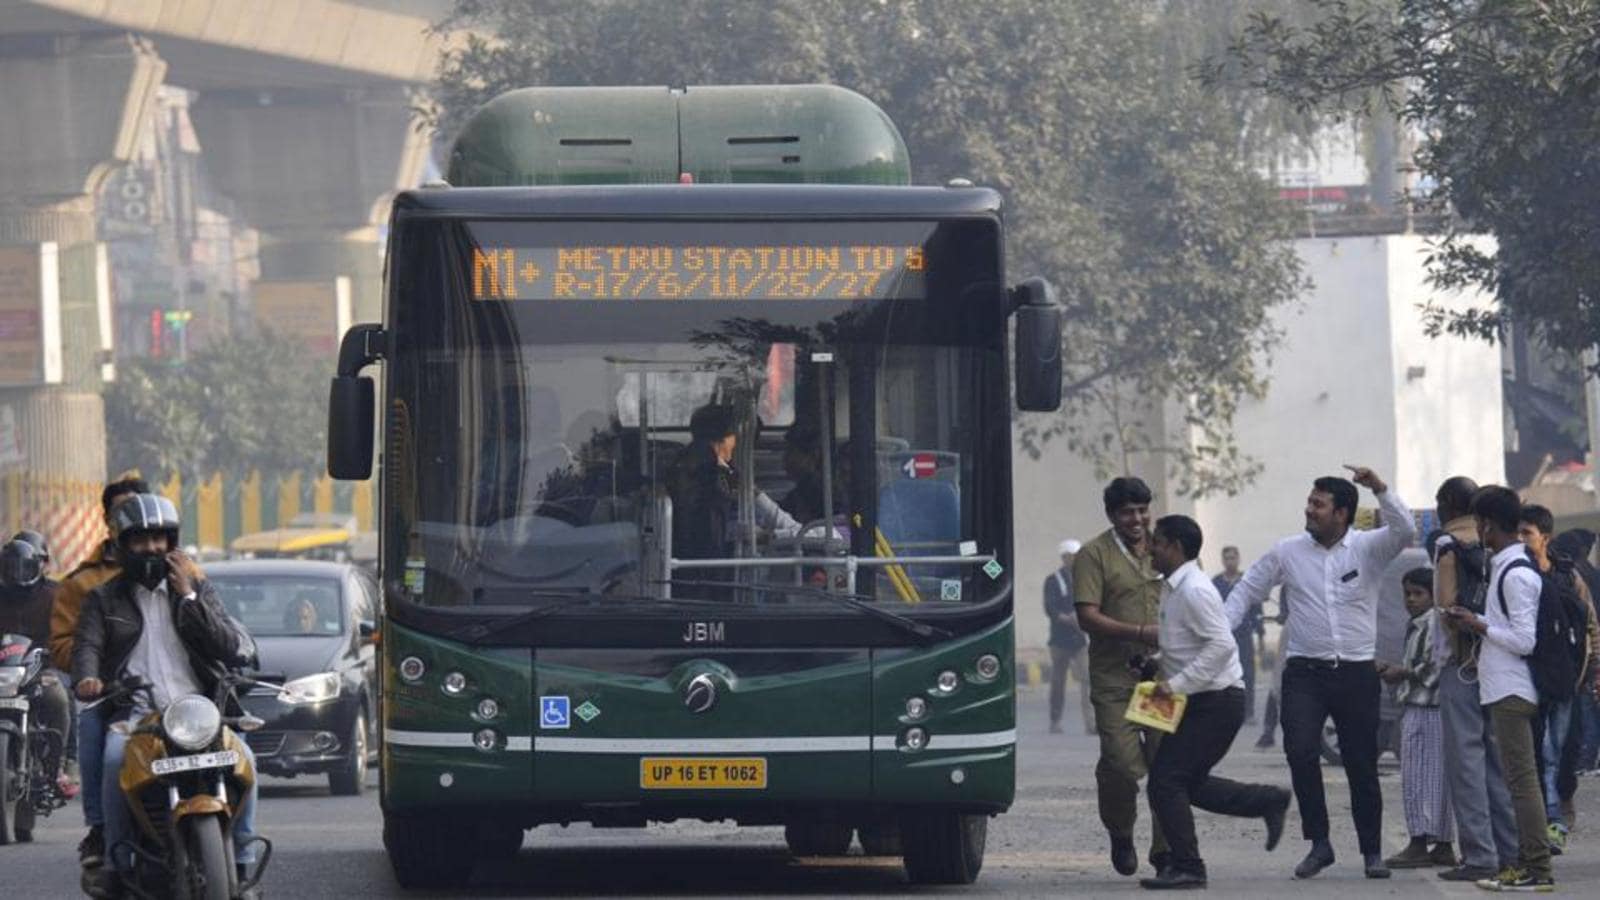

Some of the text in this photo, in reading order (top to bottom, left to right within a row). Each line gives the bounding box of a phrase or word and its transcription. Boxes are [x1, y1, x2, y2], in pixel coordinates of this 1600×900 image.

[558, 247, 673, 270] METRO
[683, 247, 841, 270] STATION
[851, 247, 895, 270] TO
[554, 272, 882, 297] R-17/6/11/25/27
[682, 621, 725, 643] JBM
[652, 766, 758, 781] UP 16 ET 1062
